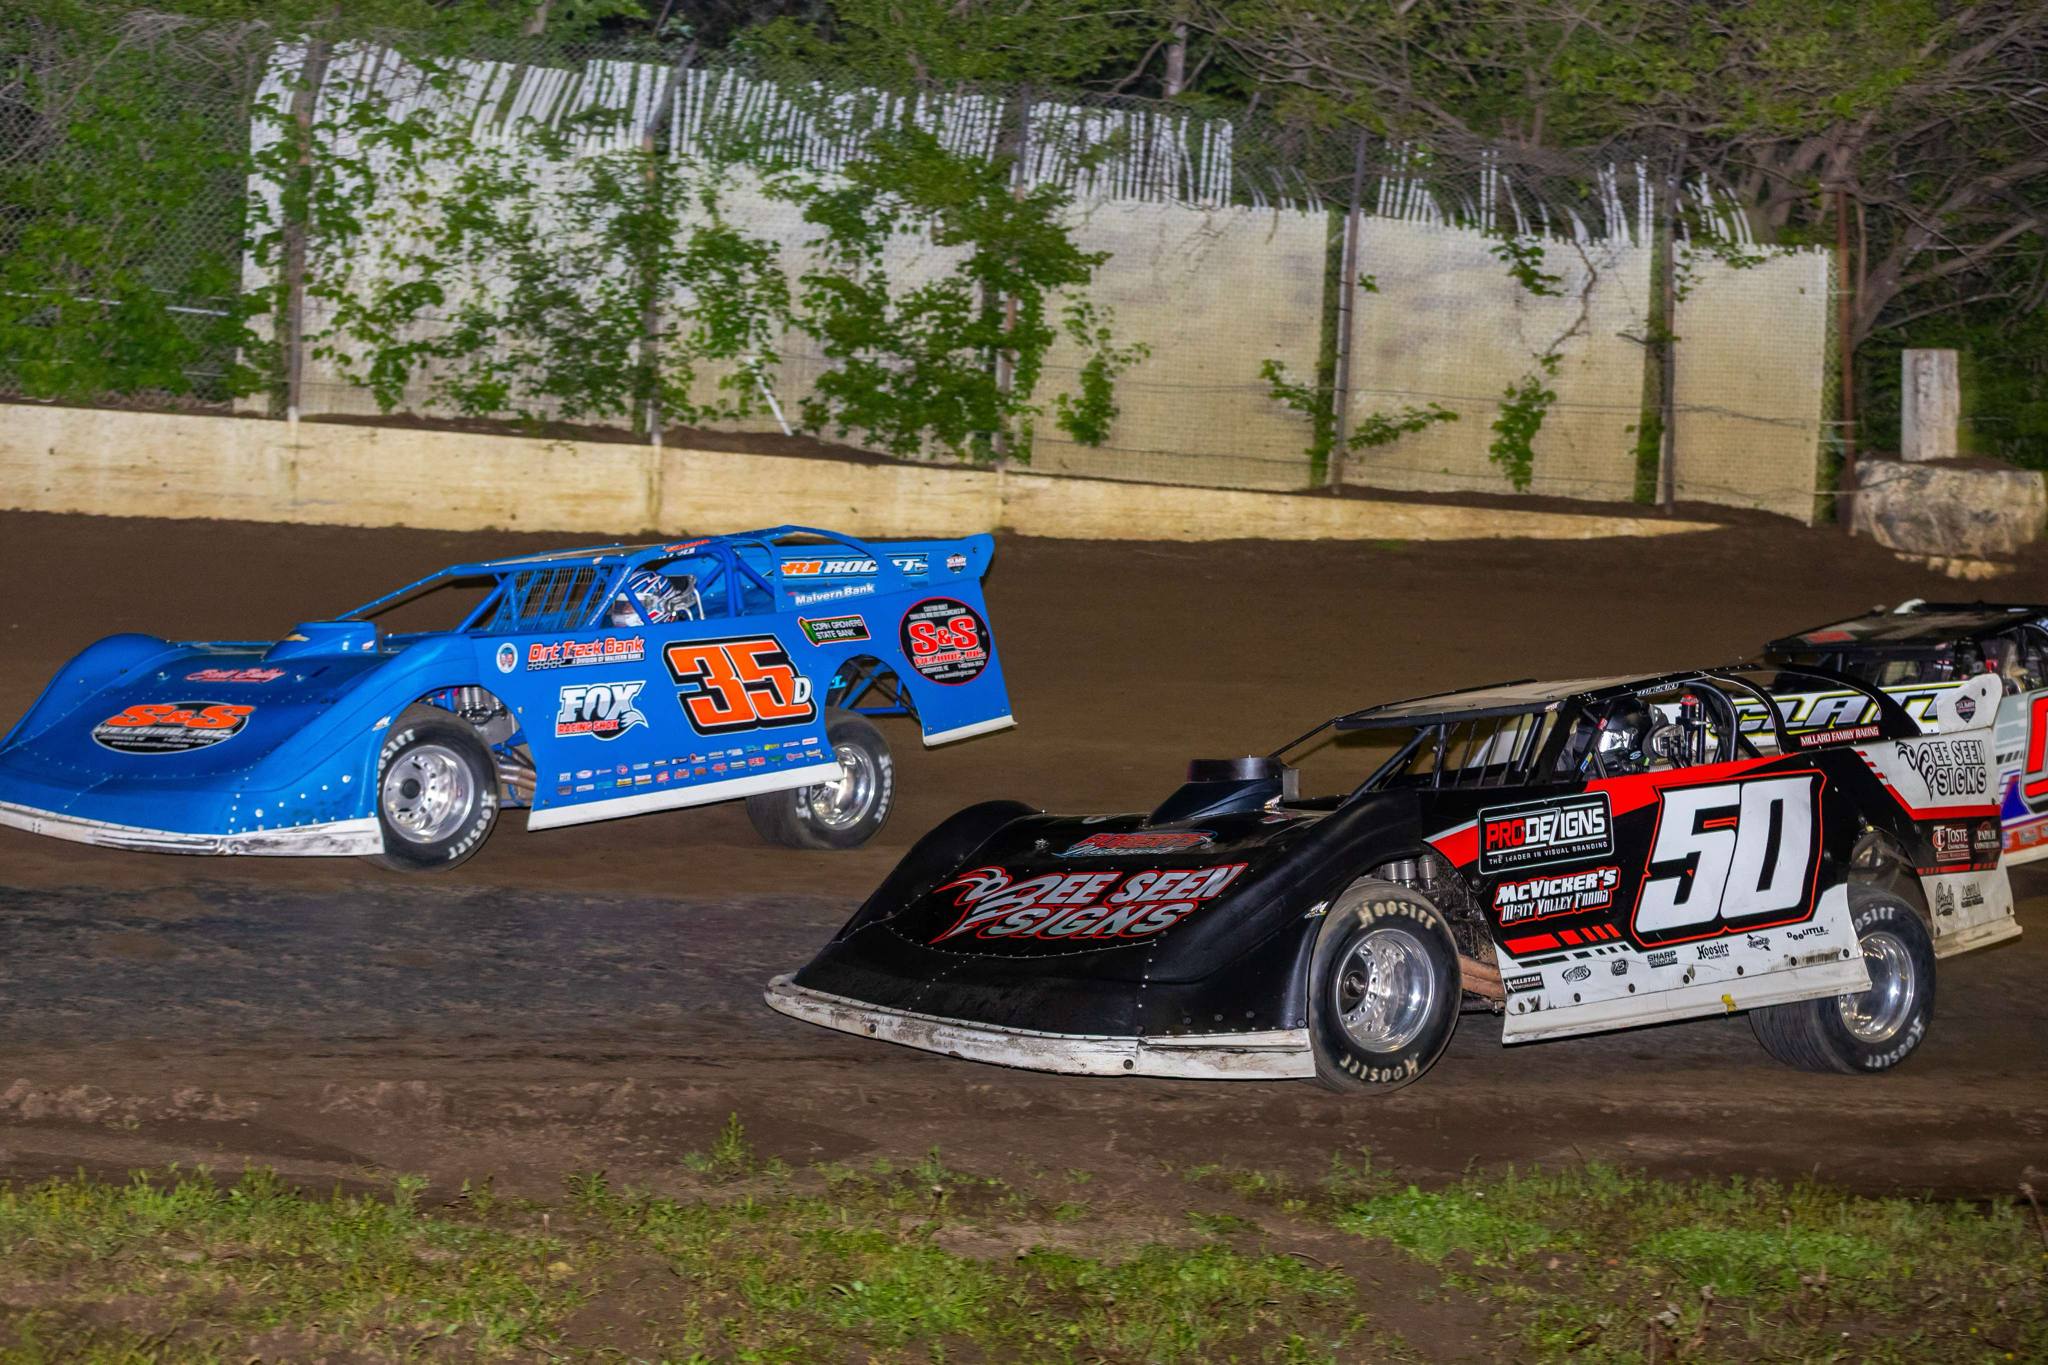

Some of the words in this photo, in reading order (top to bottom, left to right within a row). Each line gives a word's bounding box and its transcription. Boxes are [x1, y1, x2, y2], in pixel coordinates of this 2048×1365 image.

[795, 590, 842, 606] Malvern
[844, 584, 875, 597] Bank
[811, 621, 830, 631] CORN
[832, 618, 864, 629] GROWERS
[816, 630, 837, 640] STATE
[838, 629, 856, 638] BANK
[908, 615, 979, 655] S&S
[528, 642, 561, 661] Dirt
[563, 638, 604, 658] Track
[605, 635, 644, 655] Bank
[668, 638, 812, 728] 35
[792, 675, 813, 705] D
[106, 703, 256, 728] S&S
[560, 684, 641, 723] FOX
[1800, 733, 1831, 746] MILLARD
[1855, 726, 1879, 739] RACING
[1952, 739, 1985, 766] SEEN
[1936, 766, 1987, 796] SIGNS
[1489, 854, 1503, 865] THE
[1534, 850, 1542, 858] IN
[1544, 847, 1569, 856] VISUAL
[1572, 841, 1609, 853] BRANDING
[1635, 776, 1813, 934] 50
[1108, 865, 1244, 904] SEEN
[985, 901, 1195, 937] SIGNS
[1647, 950, 1677, 962] SHARP
[1696, 942, 1729, 960] Hoosier
[1512, 976, 1541, 985] ALLSTAR
